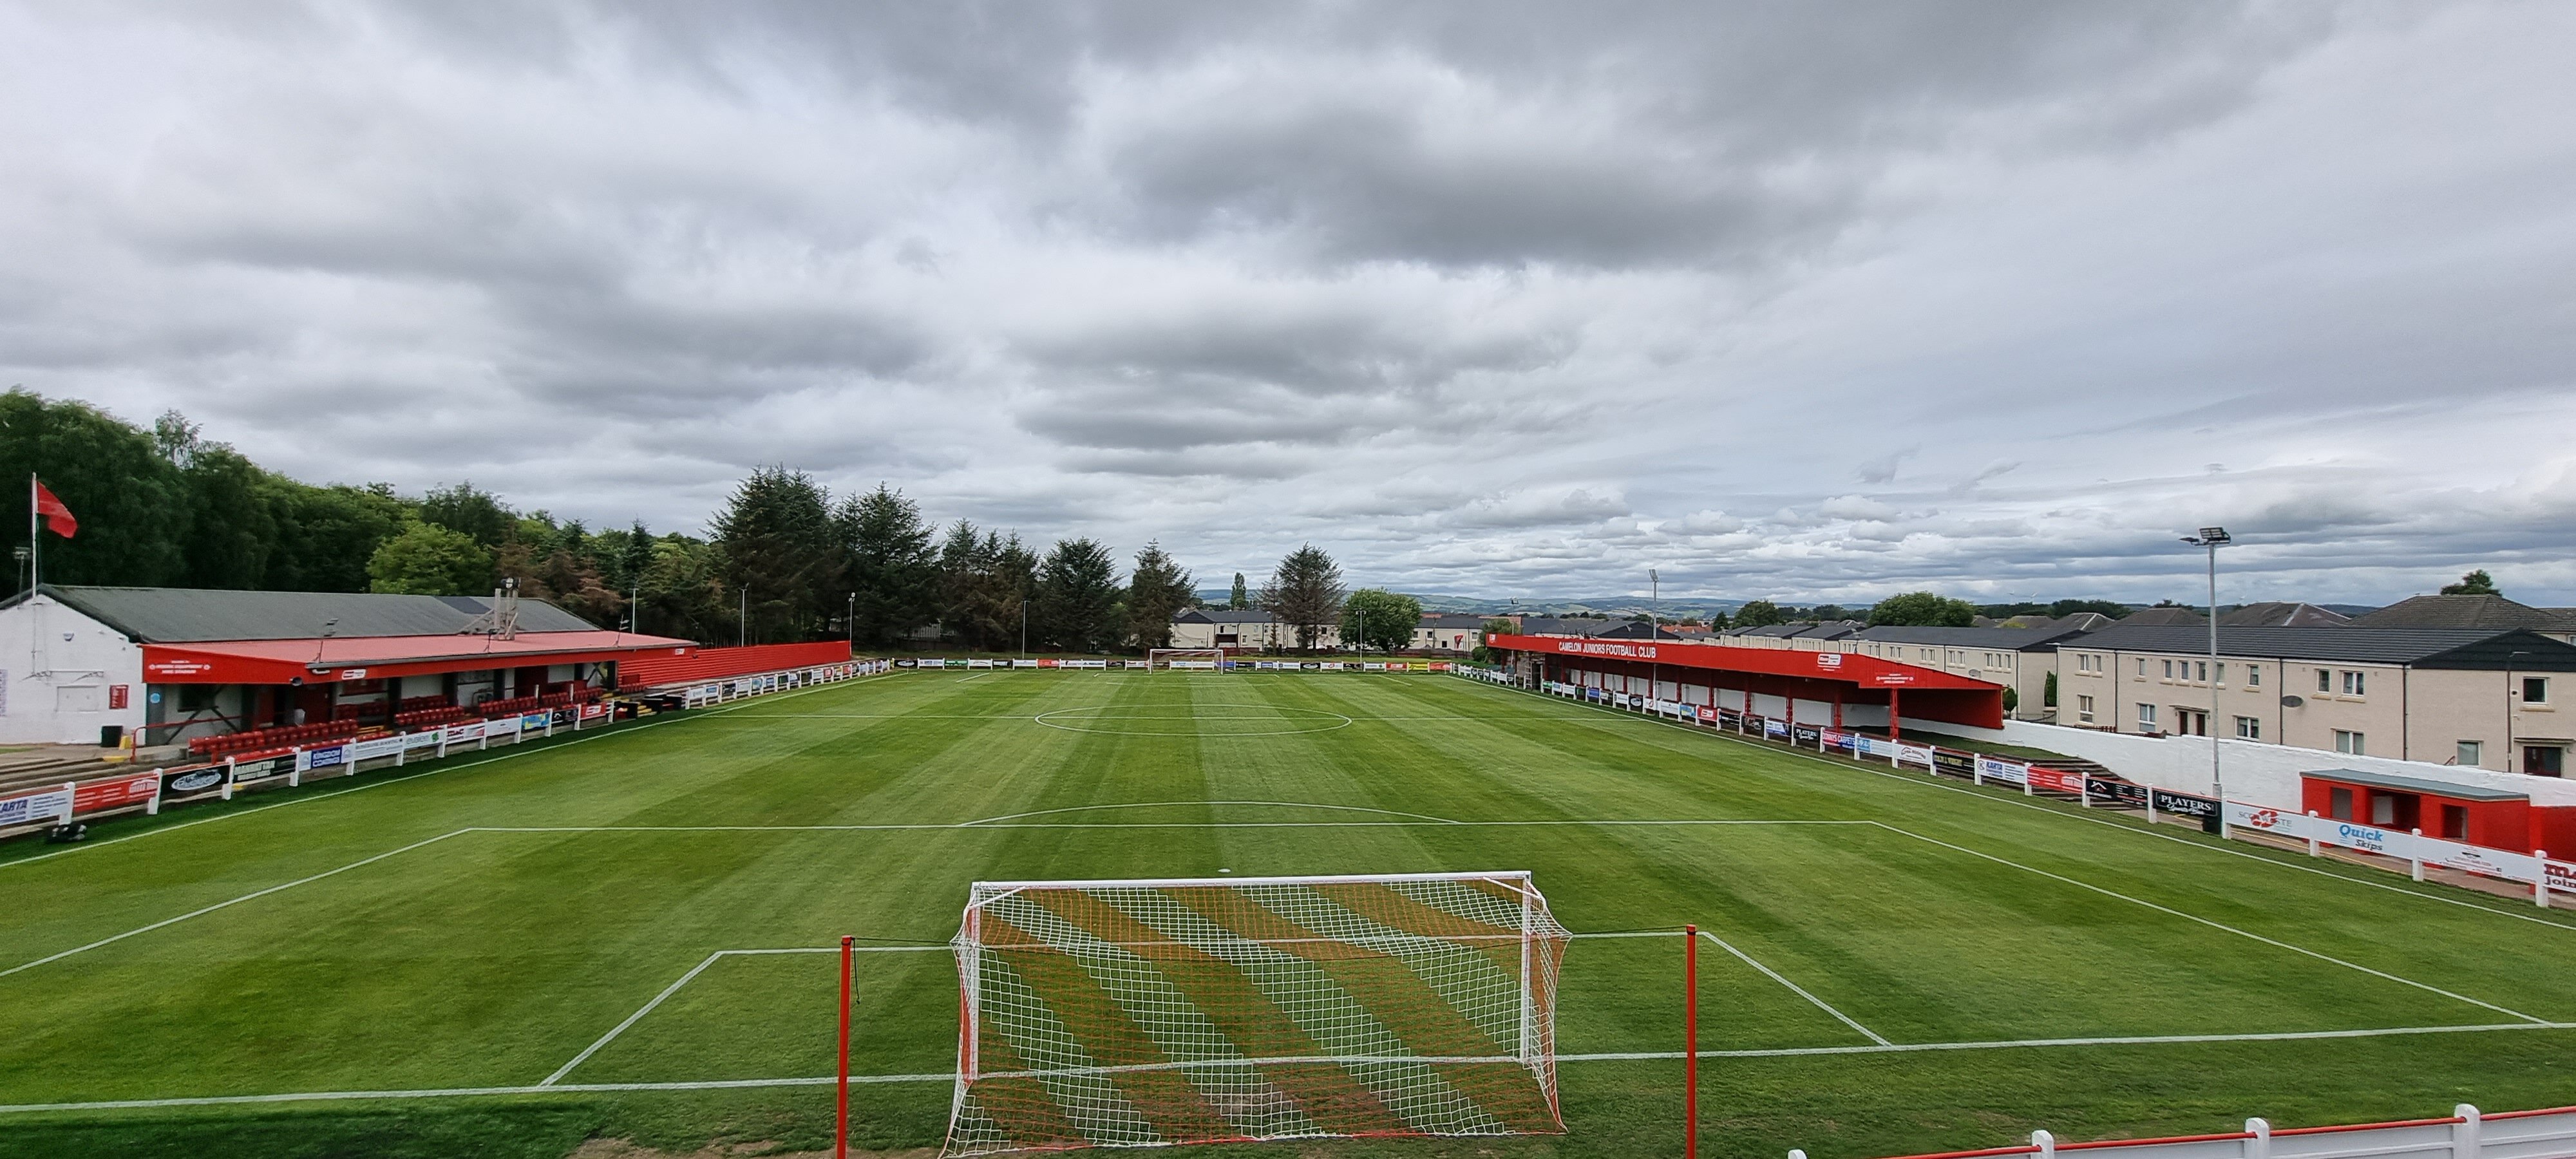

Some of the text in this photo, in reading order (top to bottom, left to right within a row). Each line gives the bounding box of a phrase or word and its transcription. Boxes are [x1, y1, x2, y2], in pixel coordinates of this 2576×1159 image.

[1558, 641, 1656, 658] CAMELON JUNIORS FOOTBALL CLUB
[1986, 762, 2003, 771] KARTA
[2161, 795, 2211, 811] PLAYERS
[2237, 811, 2293, 827] SCWSTE
[2339, 824, 2383, 842] Quick
[2355, 839, 2383, 851] Skips
